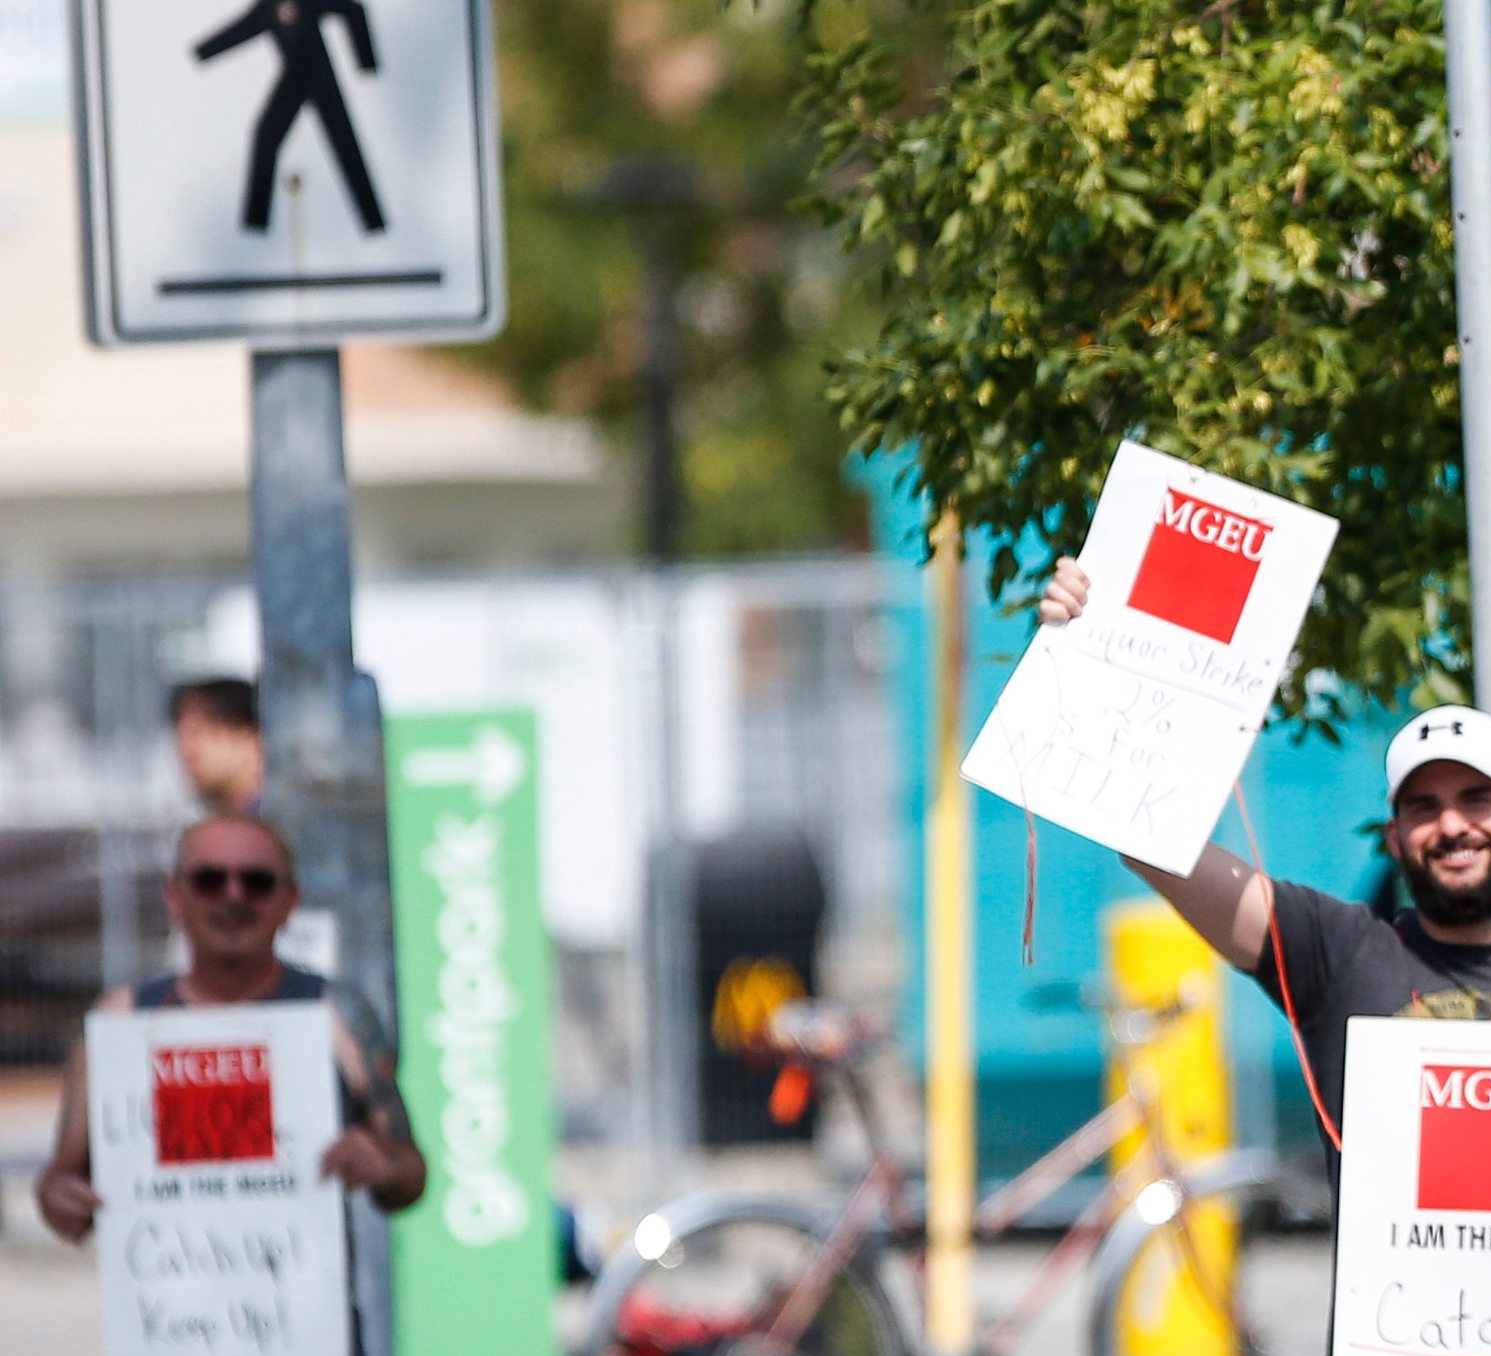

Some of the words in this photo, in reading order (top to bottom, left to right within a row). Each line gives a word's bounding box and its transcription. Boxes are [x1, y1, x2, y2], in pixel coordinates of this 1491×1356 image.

[1153, 490, 1272, 563] MGEU
[1178, 639, 1265, 698] Strike
[1000, 729, 1177, 836] MILK
[418, 806, 532, 1249] grantpark
[152, 1049, 268, 1086] MGEU
[1390, 1222, 1397, 1248] I
[1407, 1223, 1446, 1250] AM
